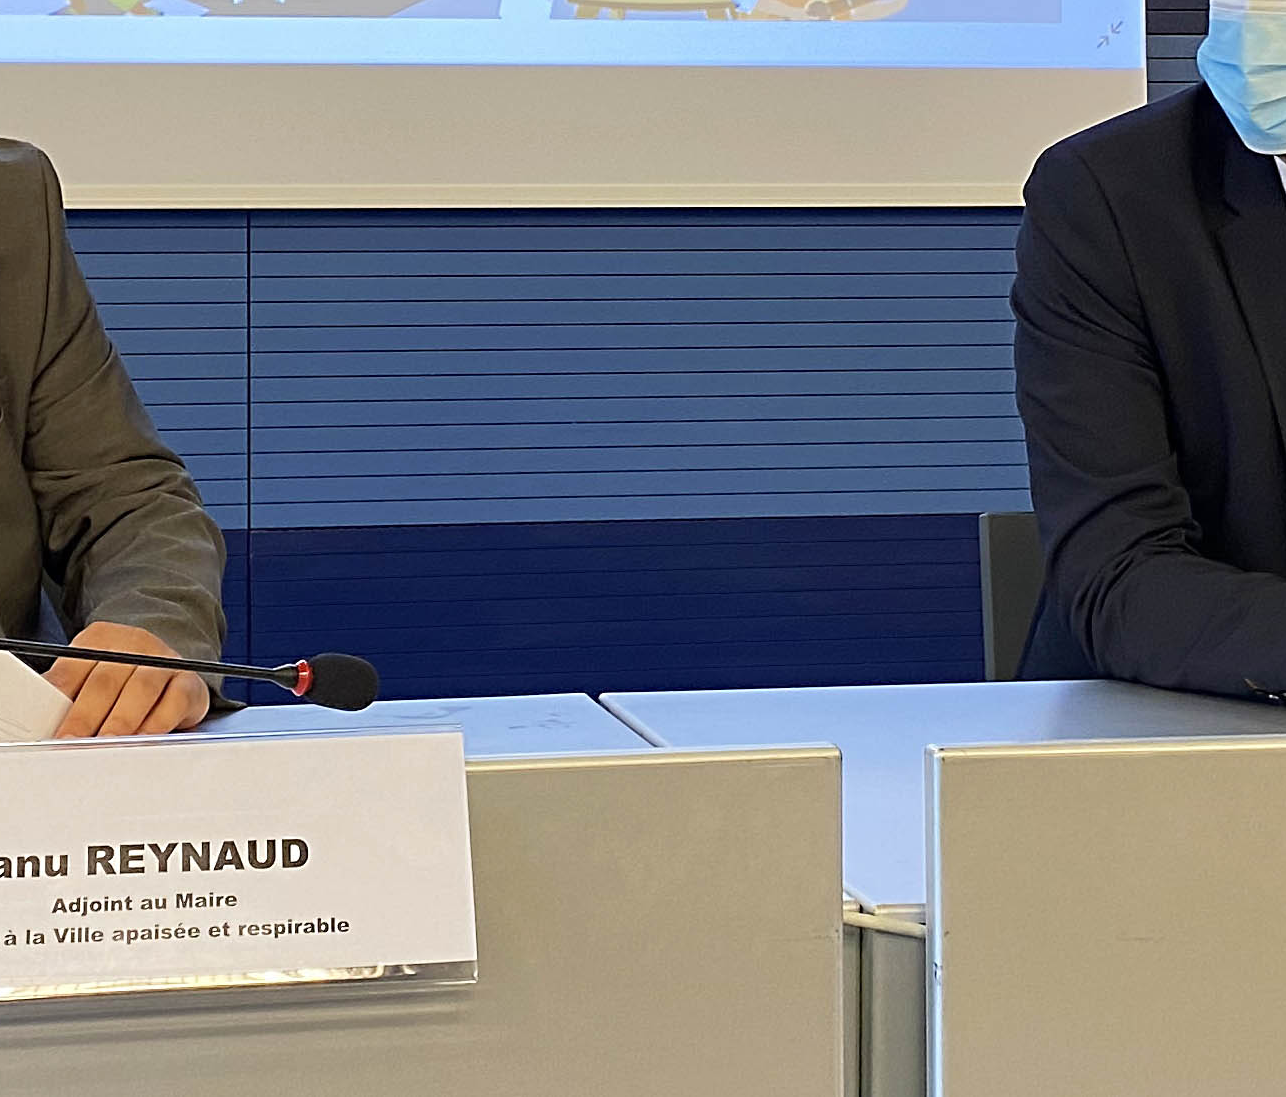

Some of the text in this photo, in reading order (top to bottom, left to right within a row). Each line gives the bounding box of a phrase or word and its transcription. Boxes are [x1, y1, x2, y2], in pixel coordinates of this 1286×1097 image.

[87, 838, 310, 876] REYNAUD
[52, 892, 238, 916] Adjoint au Maire
[3, 929, 17, 947] à
[26, 929, 46, 946] la
[53, 926, 104, 944] Ville
[112, 923, 201, 944] apaisée
[208, 922, 230, 939] et
[238, 916, 350, 941] respirable
